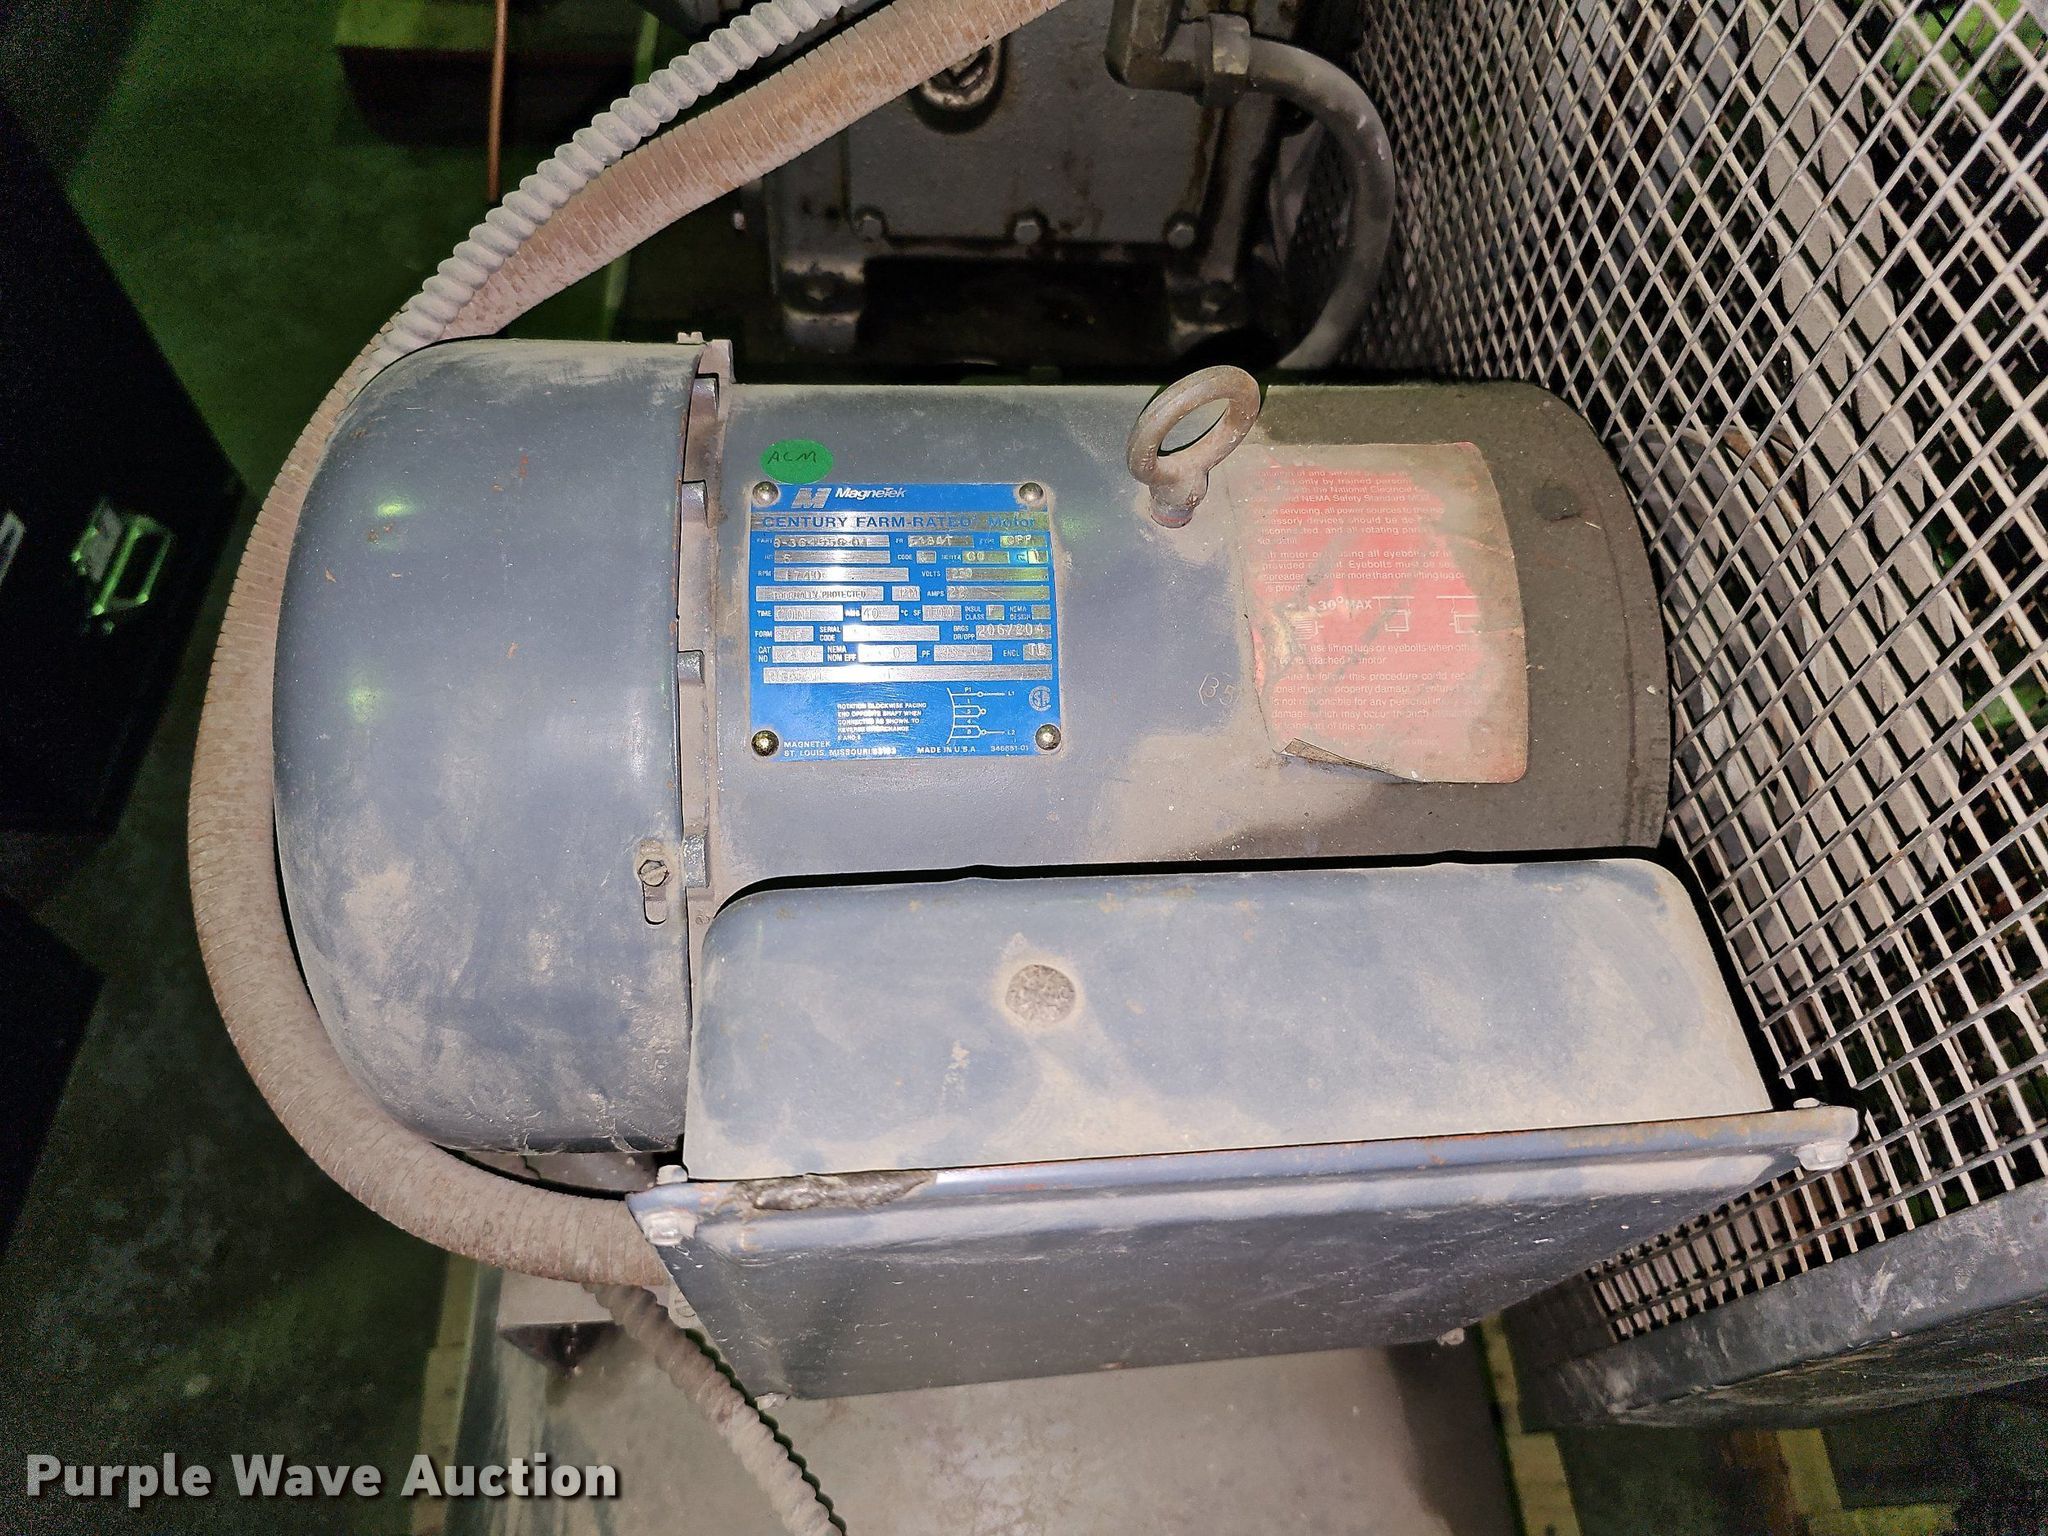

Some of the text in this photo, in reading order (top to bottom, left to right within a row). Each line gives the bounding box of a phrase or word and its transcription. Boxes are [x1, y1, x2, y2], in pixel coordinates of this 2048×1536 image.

[767, 450, 817, 465] ACM
[1322, 479, 1334, 487] by
[835, 486, 907, 501] MagneTek
[1332, 494, 1361, 502] Safety
[762, 516, 848, 528] CENTURY
[988, 516, 1036, 528] Motor
[1280, 550, 1309, 559] motor
[1367, 549, 1380, 558] all
[1263, 561, 1305, 571] provided
[821, 589, 867, 599] PROTECTED
[964, 613, 985, 621] CLASS
[754, 630, 773, 638] FORM
[819, 634, 836, 642] CODE
[758, 646, 771, 654] CAT
[827, 645, 847, 654] NEMA
[1002, 649, 1020, 657] ENCL
[1354, 644, 1374, 654] lugs
[758, 655, 768, 663] NO
[827, 654, 843, 662] NOM
[1354, 697, 1366, 706] for
[1369, 699, 1387, 708] any
[1341, 711, 1361, 720] may
[783, 740, 831, 749] MAGNETEK
[916, 746, 941, 754] MADE
